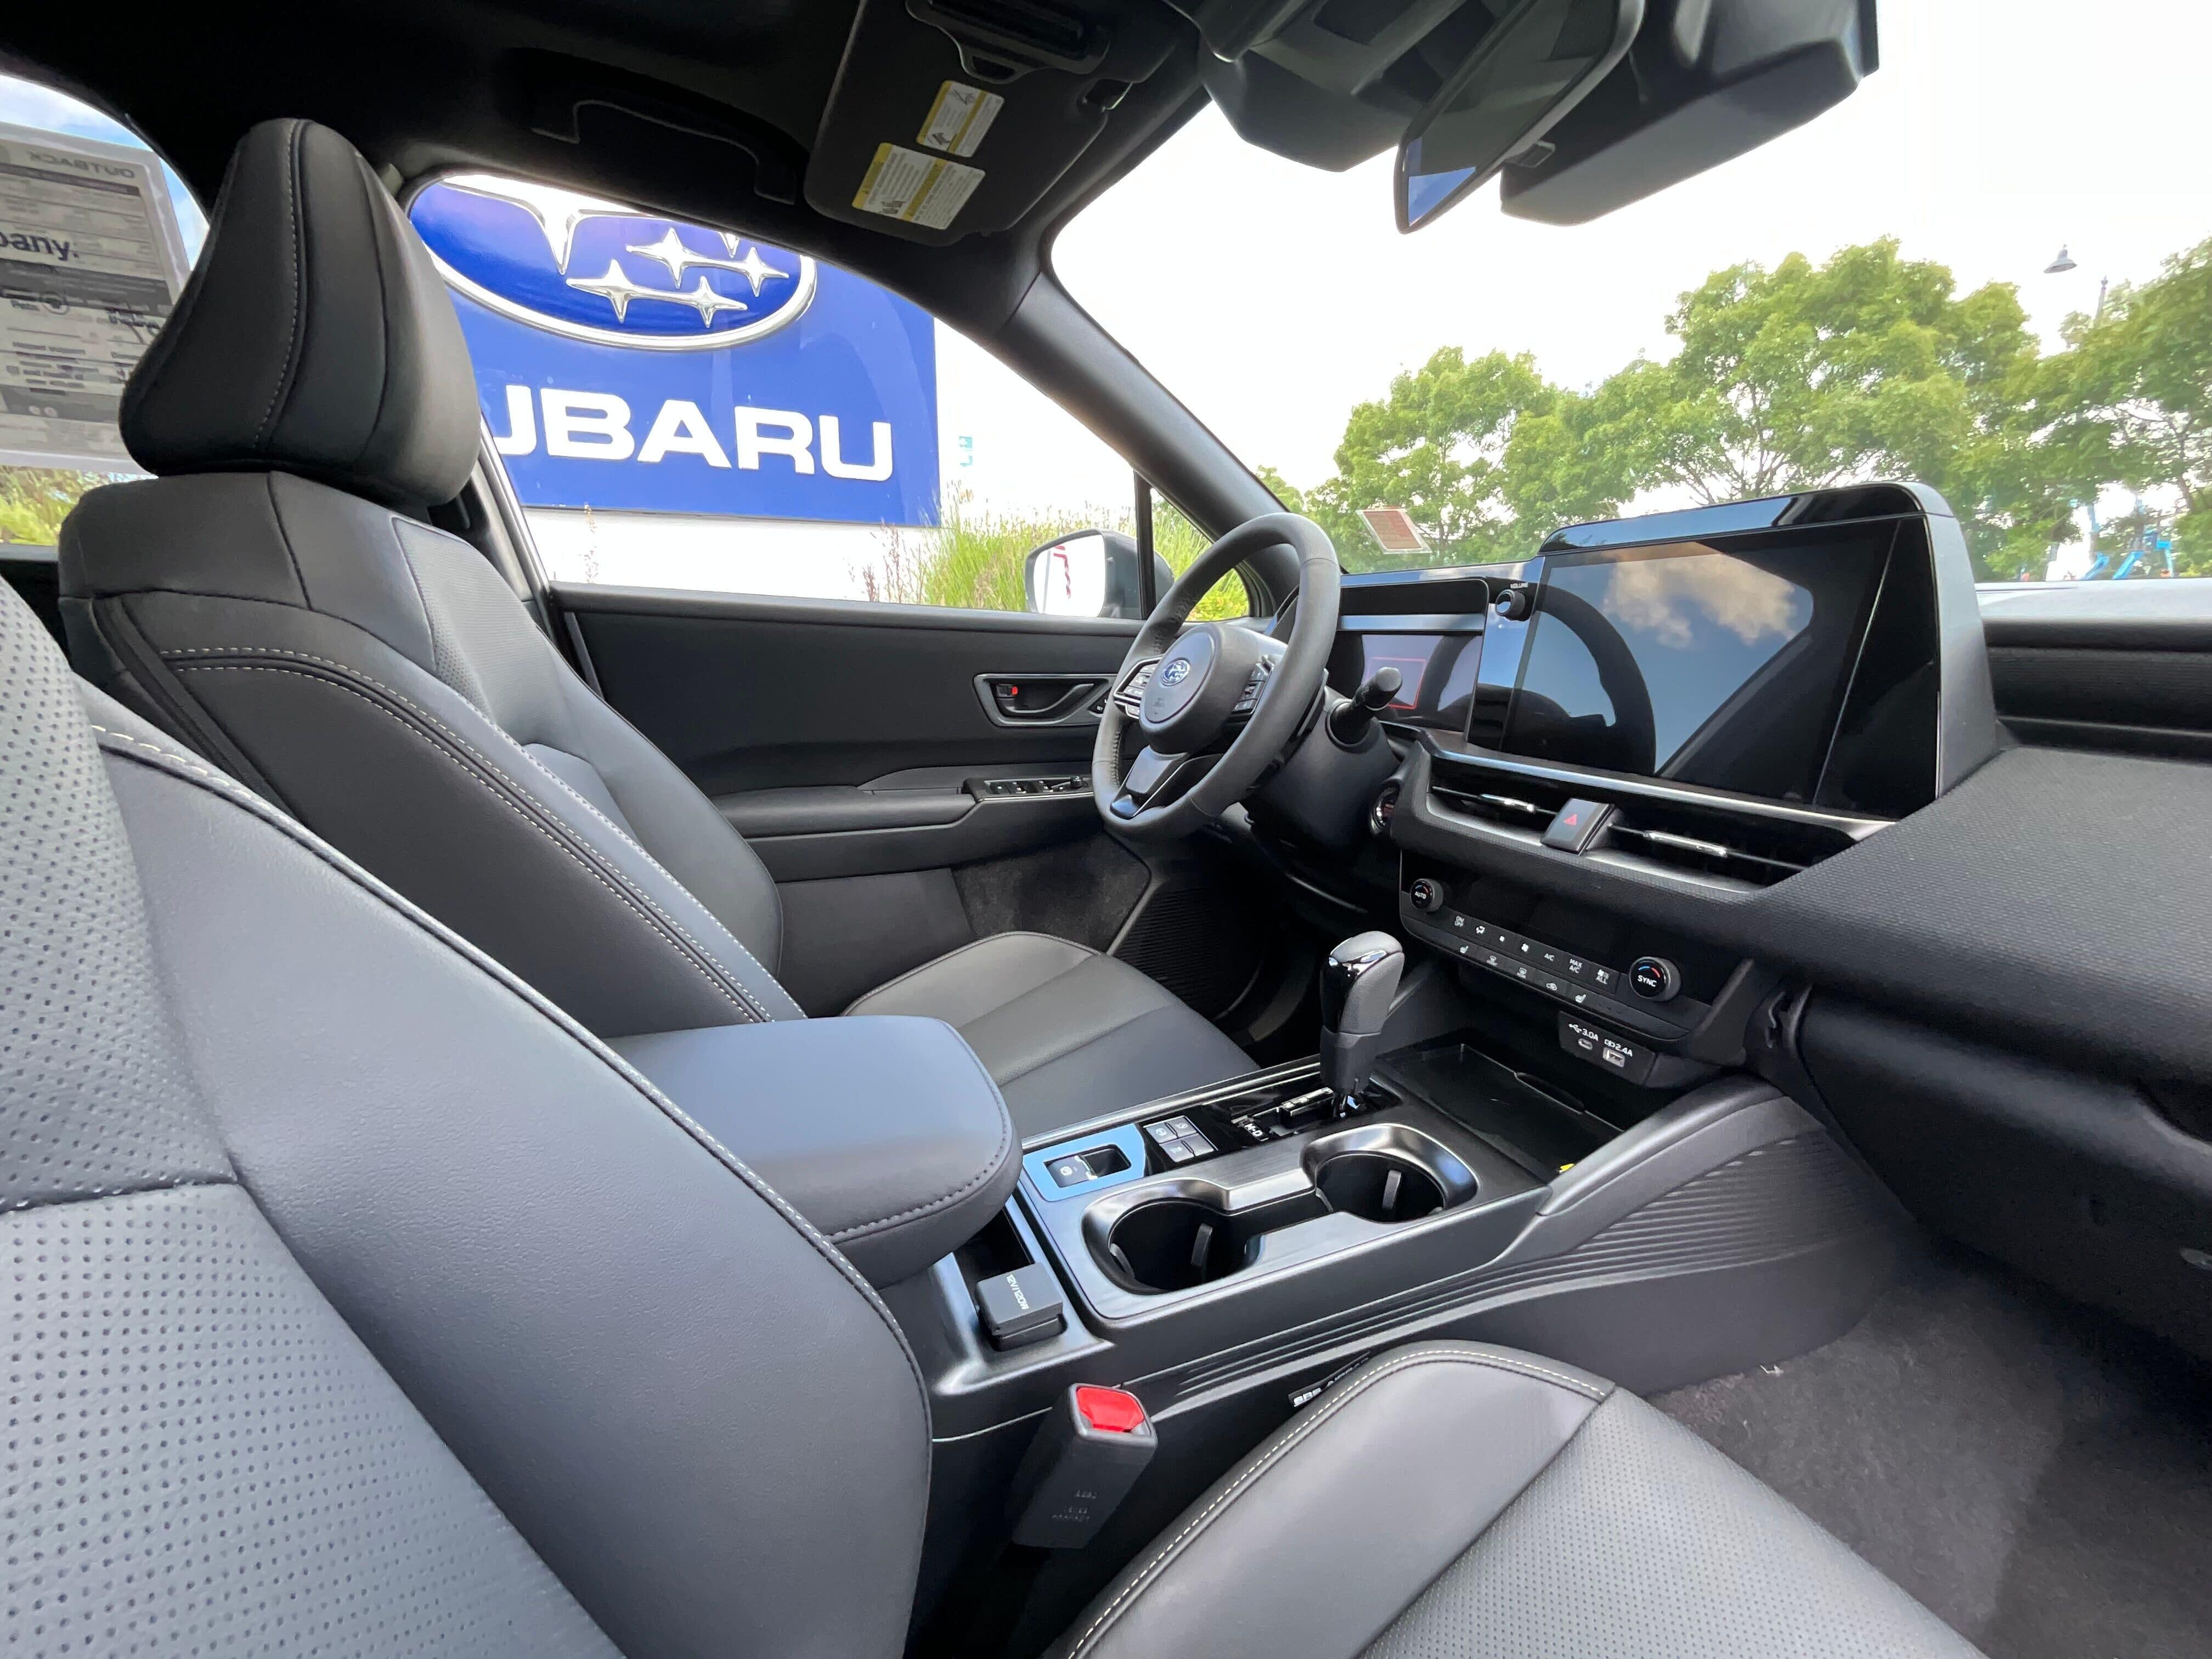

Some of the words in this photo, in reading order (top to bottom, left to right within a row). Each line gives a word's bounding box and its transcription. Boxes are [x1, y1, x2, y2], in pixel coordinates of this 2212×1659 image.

[1415, 891, 1426, 899] AUTO
[1544, 953, 1555, 961] A/C
[1569, 958, 1583, 968] MAX
[1637, 974, 1657, 988] SYNC
[1582, 1028, 1599, 1041] 3.0A
[1615, 1043, 1633, 1057] 2.4A
